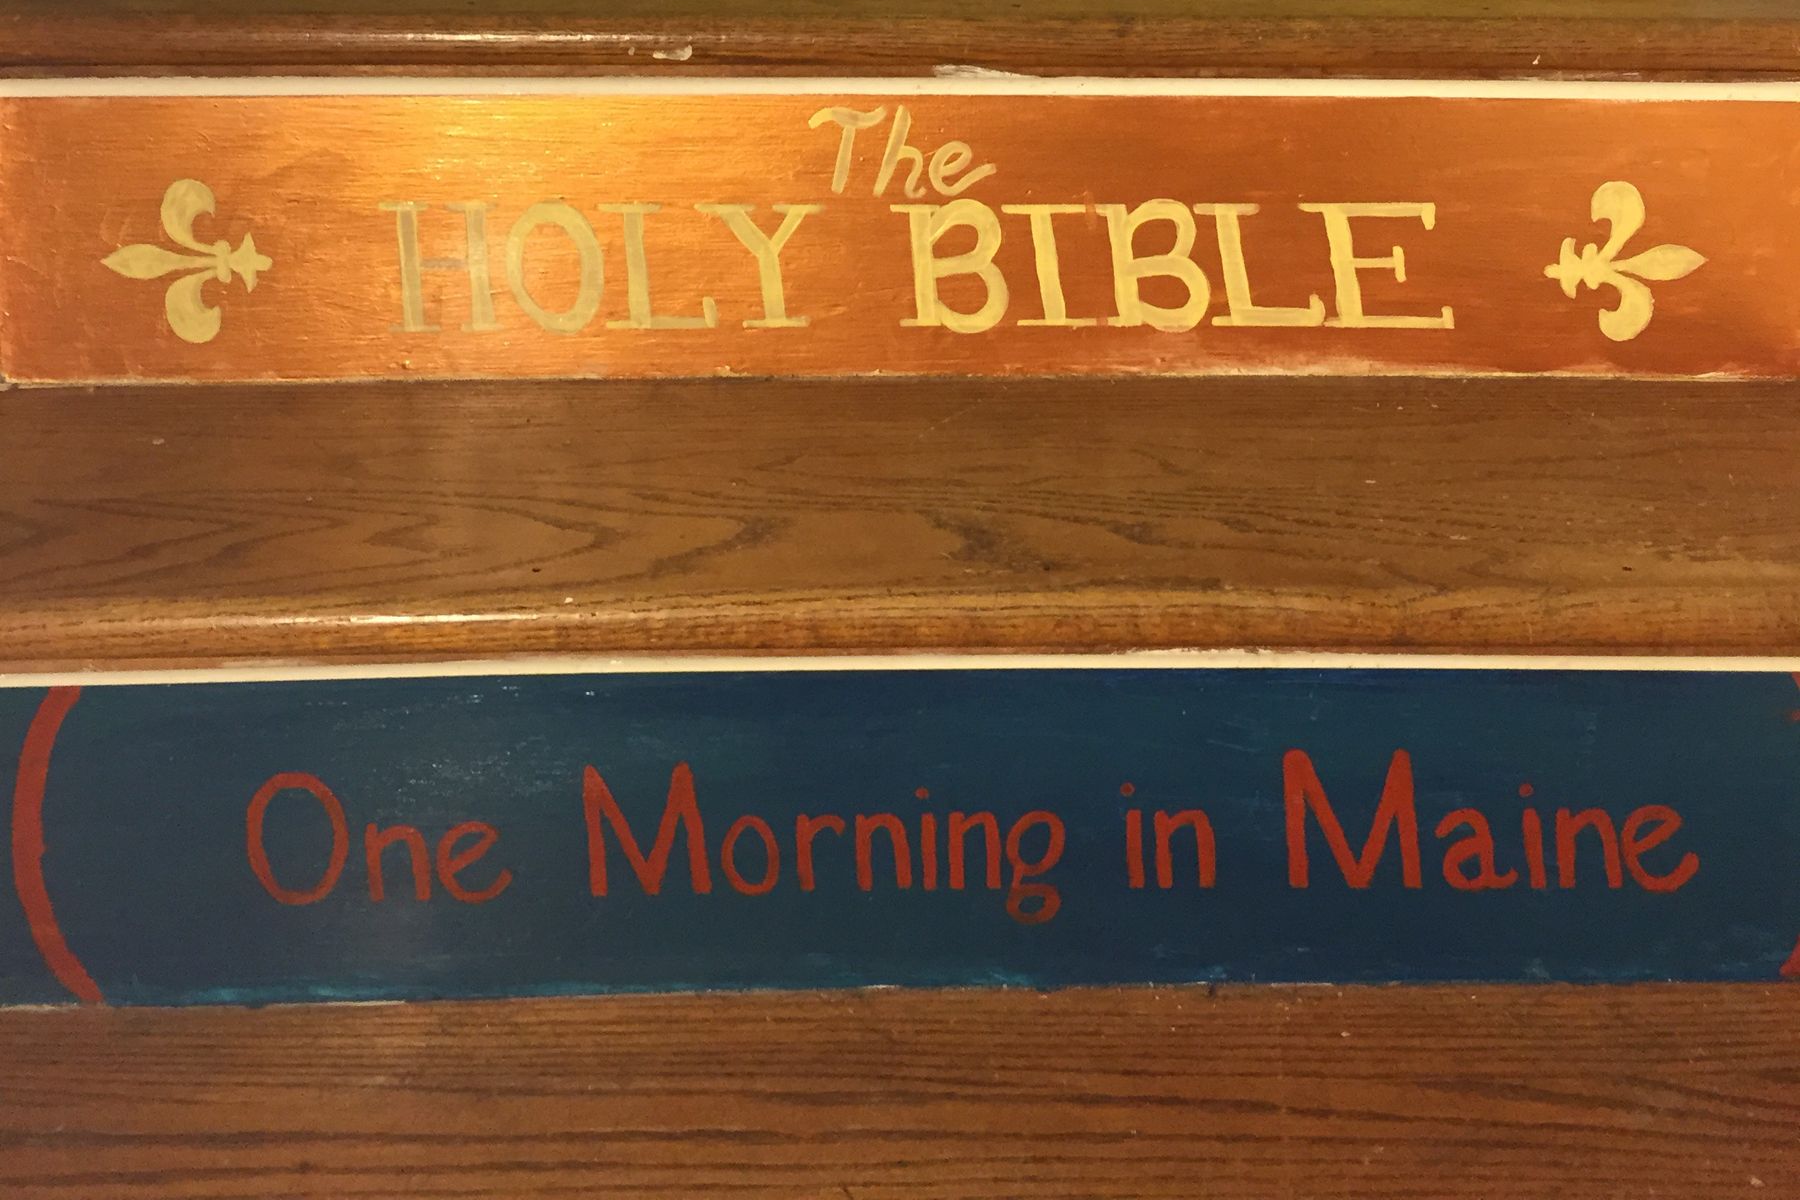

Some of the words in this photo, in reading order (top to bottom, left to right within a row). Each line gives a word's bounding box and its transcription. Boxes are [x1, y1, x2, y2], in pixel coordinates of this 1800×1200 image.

[808, 104, 997, 198] The
[378, 199, 825, 334] HOLY
[889, 198, 1455, 333] BIBLE
[246, 772, 513, 905] One
[583, 760, 1067, 924] Morning
[1119, 782, 1217, 889] in
[1282, 749, 1699, 892] Maine
